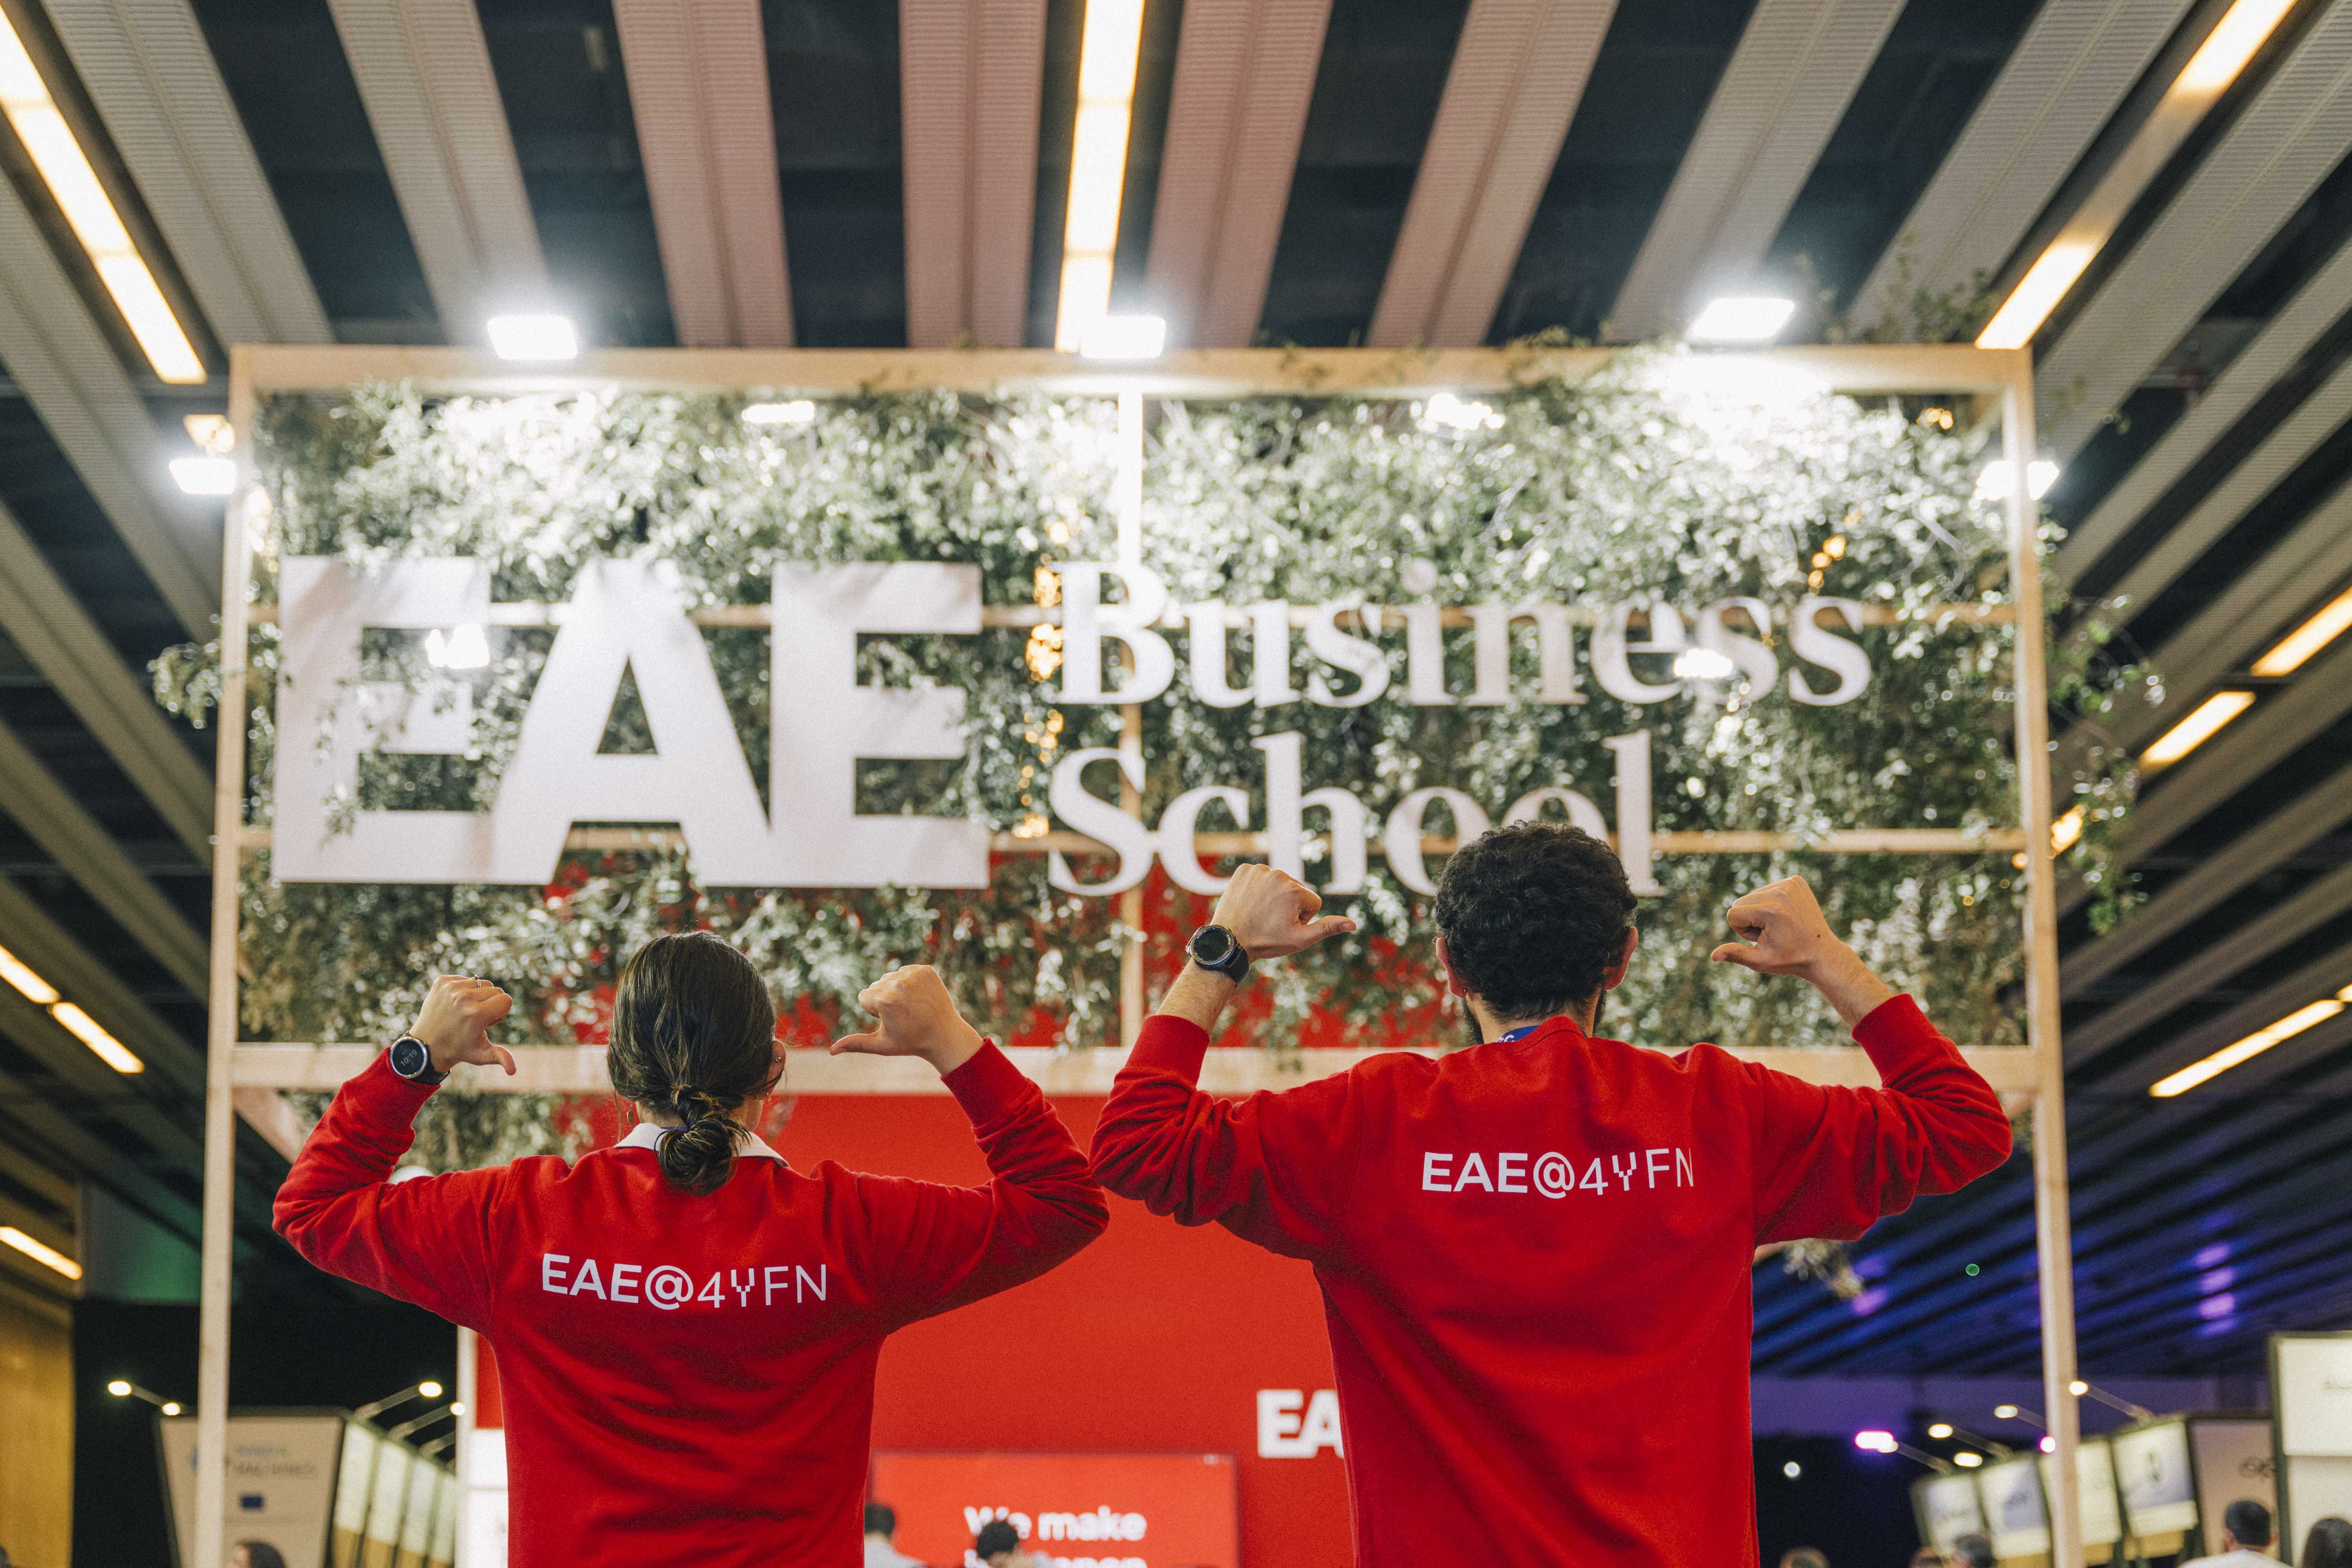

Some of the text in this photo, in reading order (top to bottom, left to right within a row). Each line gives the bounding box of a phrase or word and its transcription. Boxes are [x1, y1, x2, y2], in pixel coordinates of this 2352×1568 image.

[1046, 558, 1872, 706] Business
[272, 556, 989, 887] EAE
[1422, 1148, 1694, 1199] EAE@4YFN
[542, 1253, 826, 1310] EAE@4YFN
[1038, 1505, 1147, 1541] make
